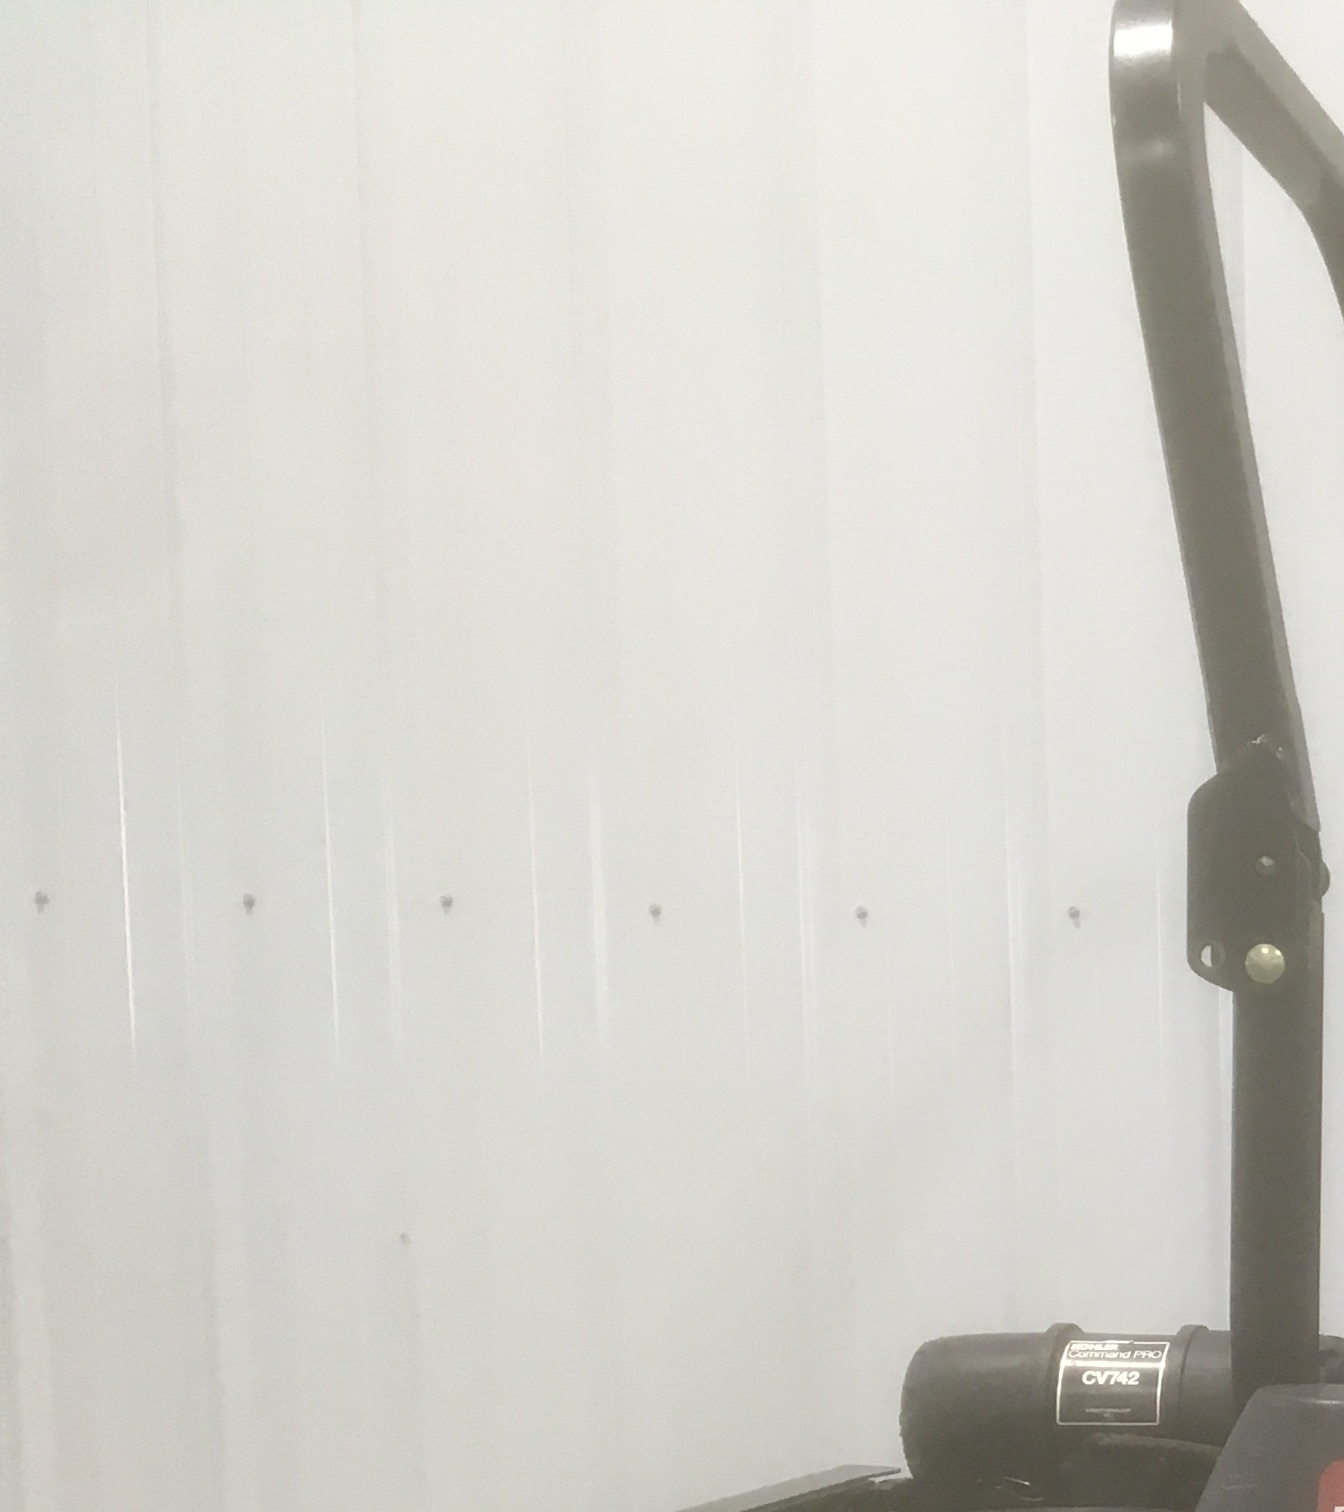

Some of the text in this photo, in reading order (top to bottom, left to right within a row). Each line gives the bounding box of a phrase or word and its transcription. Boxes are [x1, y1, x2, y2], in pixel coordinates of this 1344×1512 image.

[1068, 1350, 1163, 1359] Command PRO
[1081, 1370, 1141, 1386] CV742
